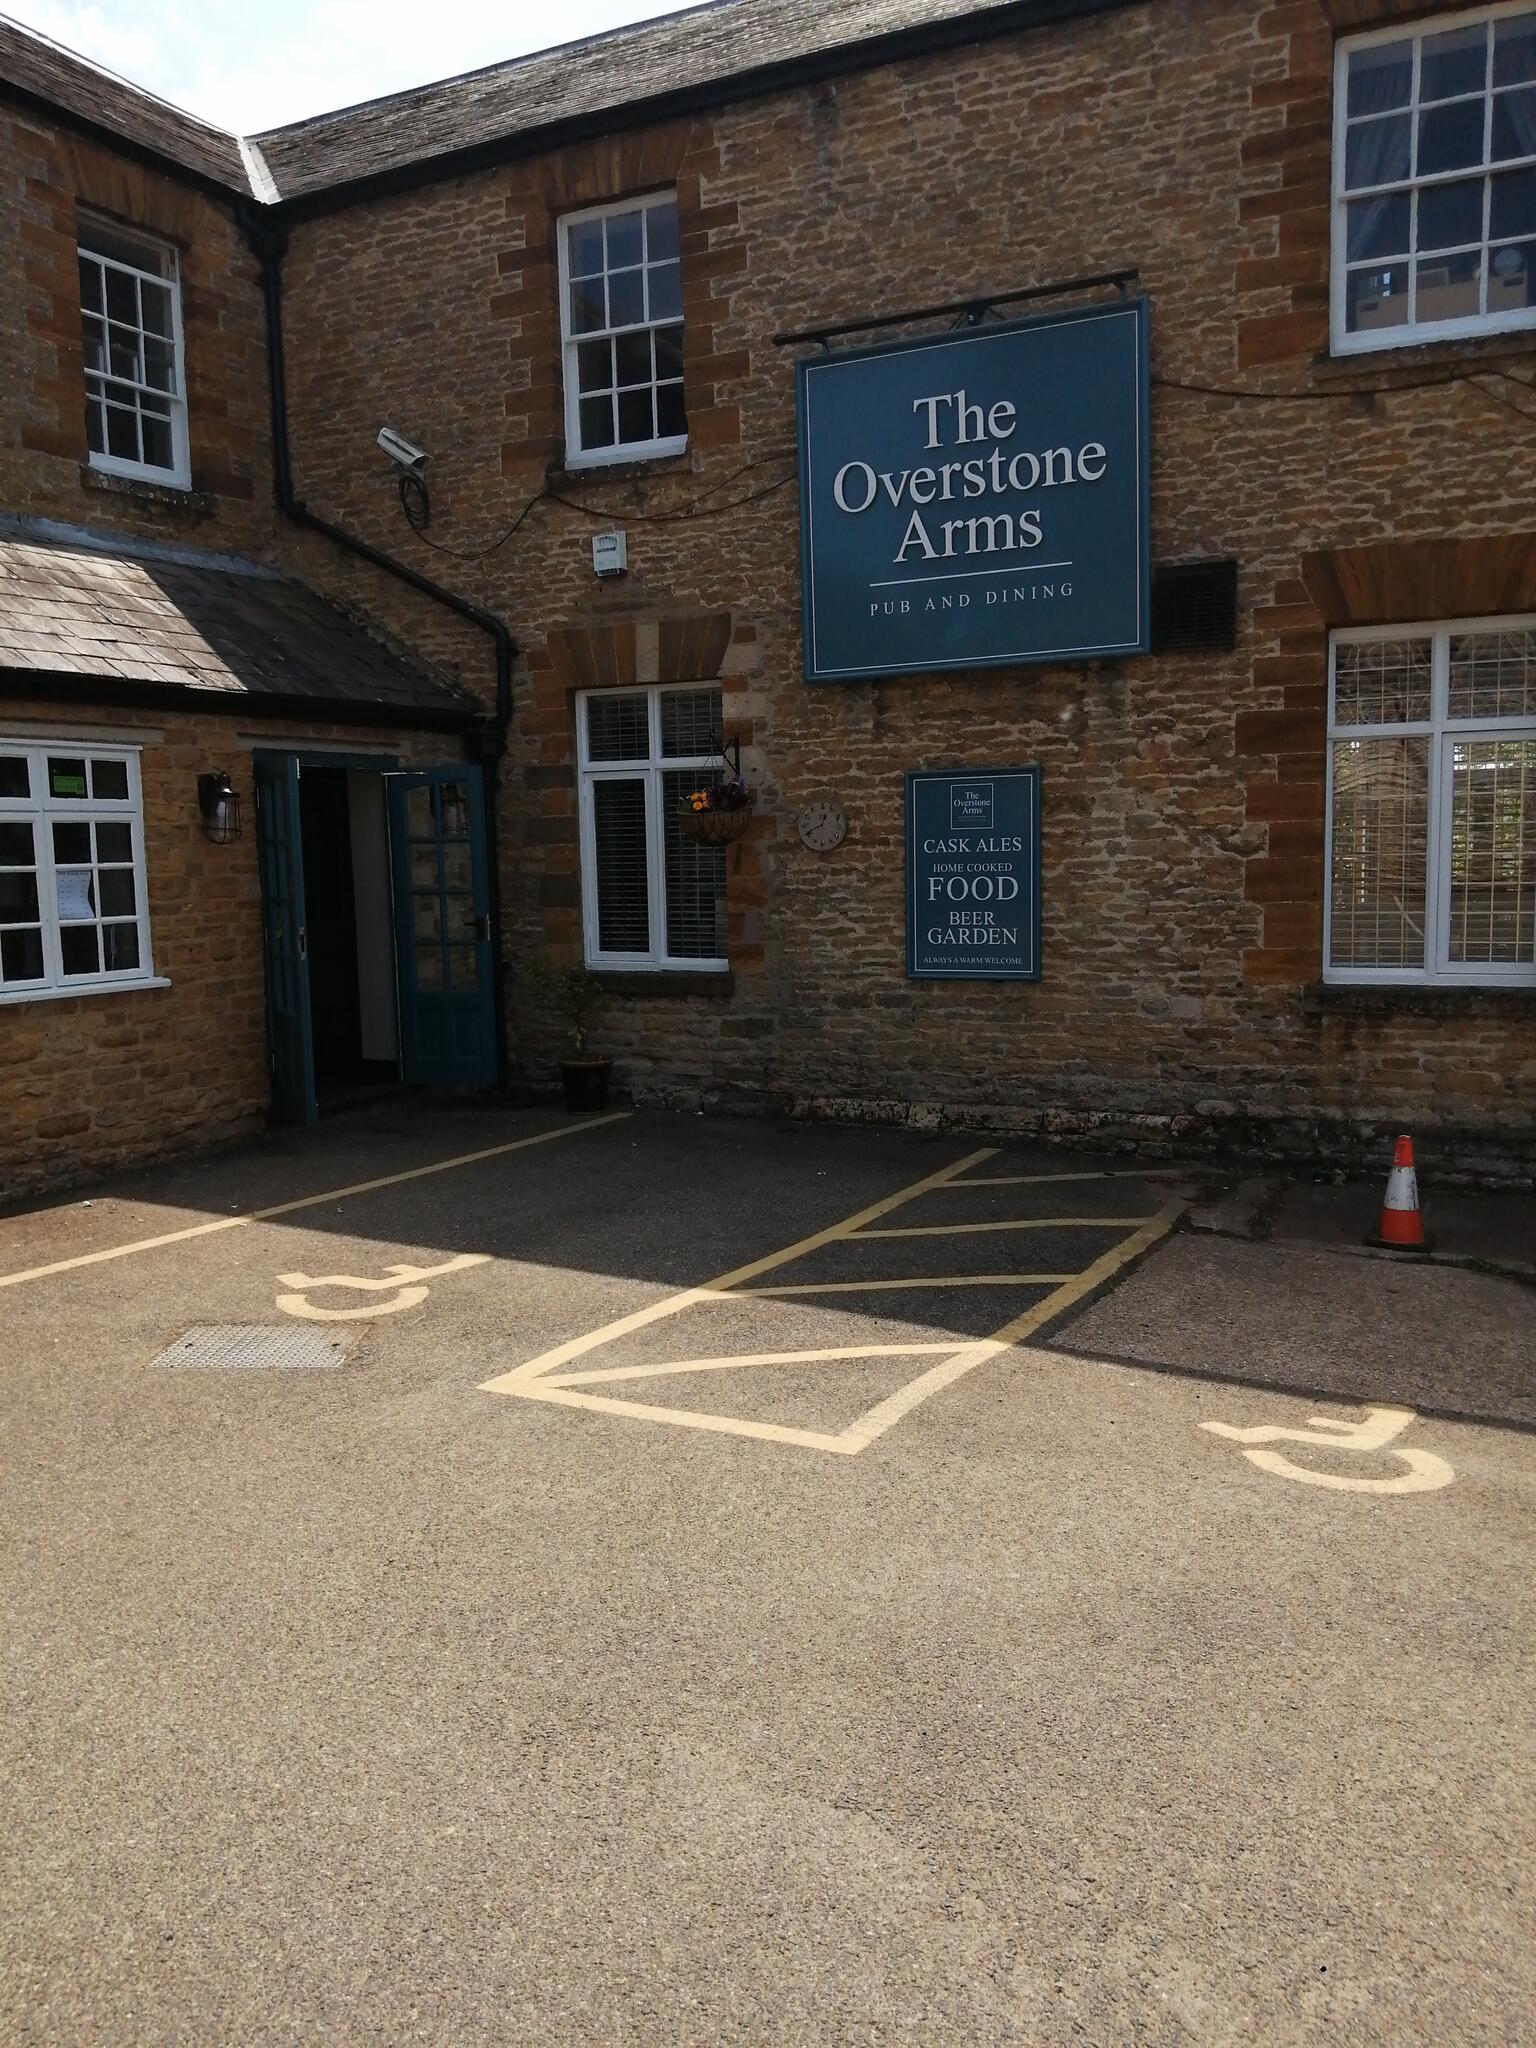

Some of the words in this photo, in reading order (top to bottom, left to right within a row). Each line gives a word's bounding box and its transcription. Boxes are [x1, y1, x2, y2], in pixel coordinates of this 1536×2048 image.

[913, 389, 1016, 449] The
[833, 441, 1107, 513] Overstone
[893, 509, 1043, 563] Arms
[870, 600, 911, 616] PUB
[925, 594, 971, 611] AND
[986, 583, 1073, 605] DINING
[953, 799, 990, 807] Overstone
[965, 791, 979, 800] The
[923, 838, 970, 853] CASK
[976, 837, 1022, 852] ALES
[933, 863, 964, 873] HOME
[966, 862, 1013, 872] COOKED
[927, 876, 1019, 901] FOOD
[949, 911, 995, 926] BEER
[927, 927, 1018, 945] GARDEN
[923, 956, 952, 964] ALWAYS
[953, 956, 959, 964] A
[985, 957, 1024, 965] WELCOME
